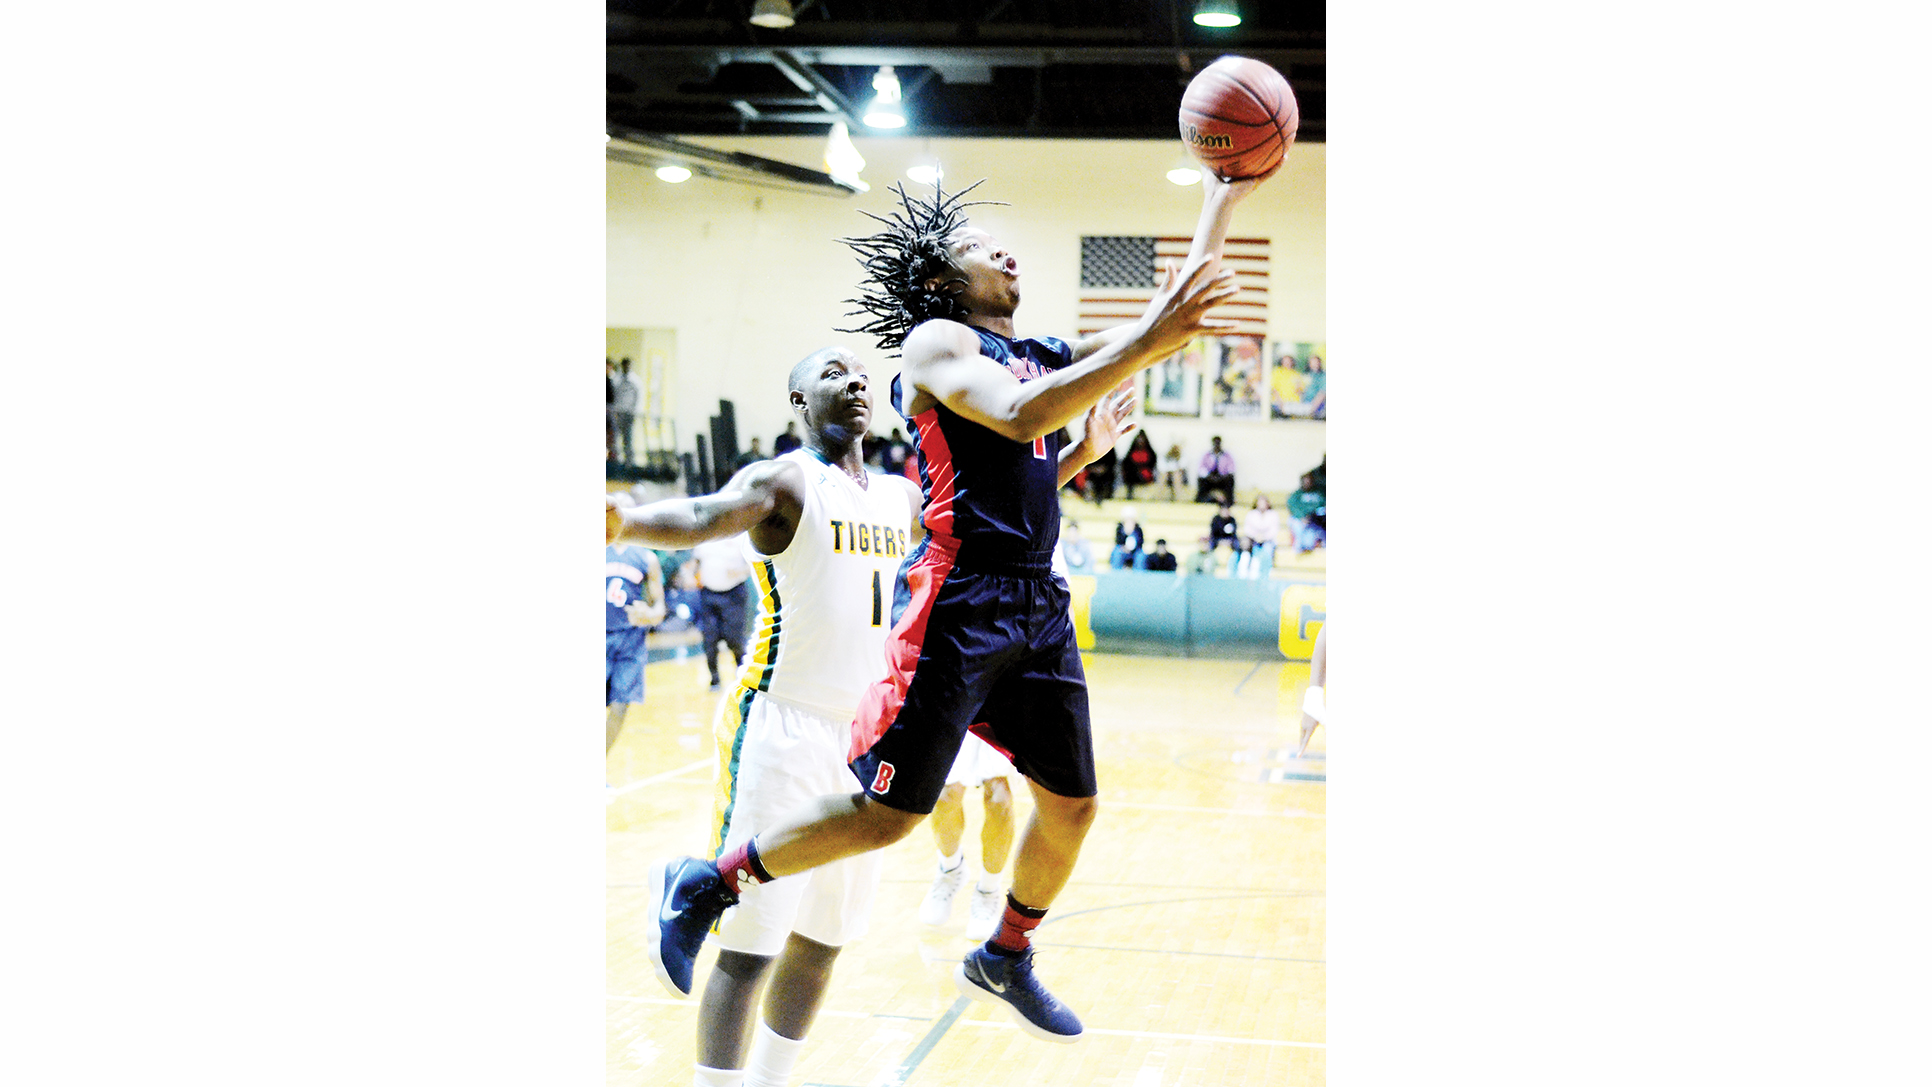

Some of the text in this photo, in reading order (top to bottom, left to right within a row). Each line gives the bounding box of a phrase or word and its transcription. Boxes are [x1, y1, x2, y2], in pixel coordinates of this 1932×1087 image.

[830, 519, 906, 559] TIGERS
[871, 569, 882, 627] 1
[870, 760, 896, 795] B
